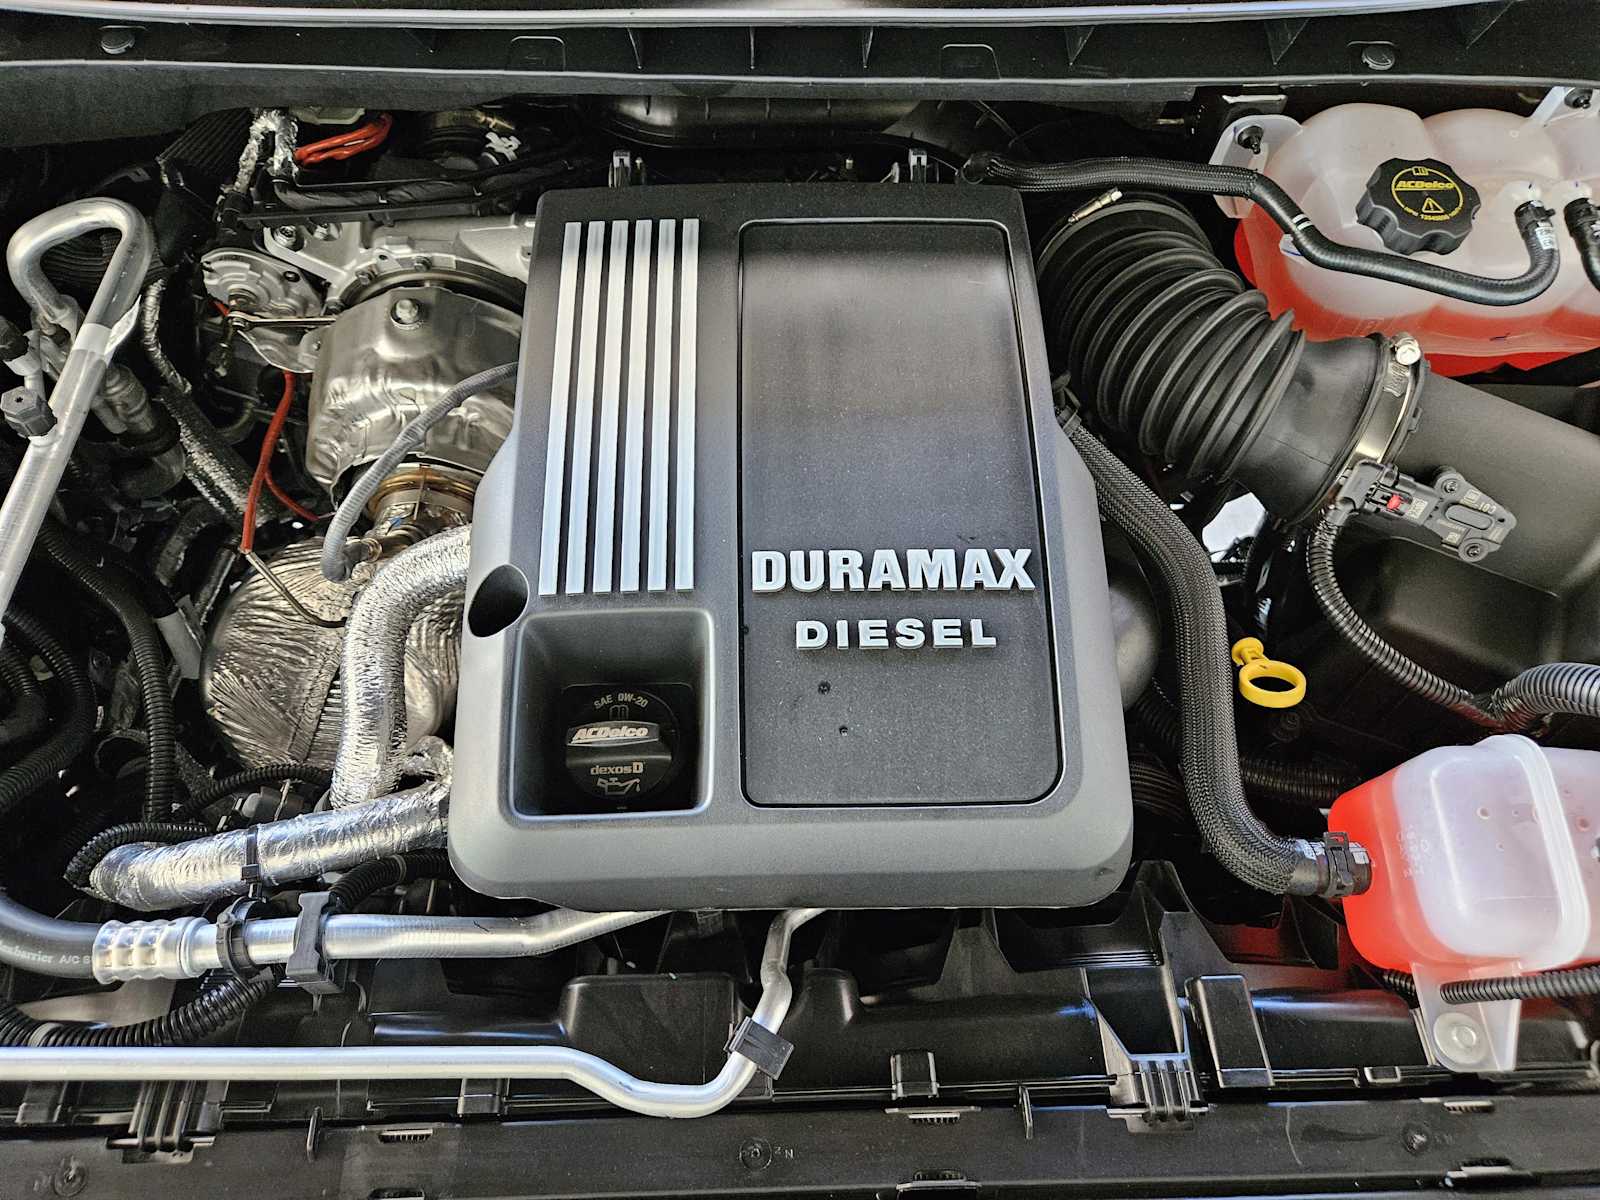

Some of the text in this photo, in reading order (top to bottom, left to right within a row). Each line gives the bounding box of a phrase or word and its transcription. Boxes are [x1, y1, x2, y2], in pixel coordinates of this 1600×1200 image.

[1395, 180, 1456, 190] ACDelco
[751, 548, 1036, 592] DURAMAX
[795, 618, 997, 650] DIESEL
[593, 692, 649, 709] SAE 0W-20
[571, 725, 649, 742] ACDelco
[590, 761, 644, 775] dexosD
[59, 953, 80, 965] A/C
